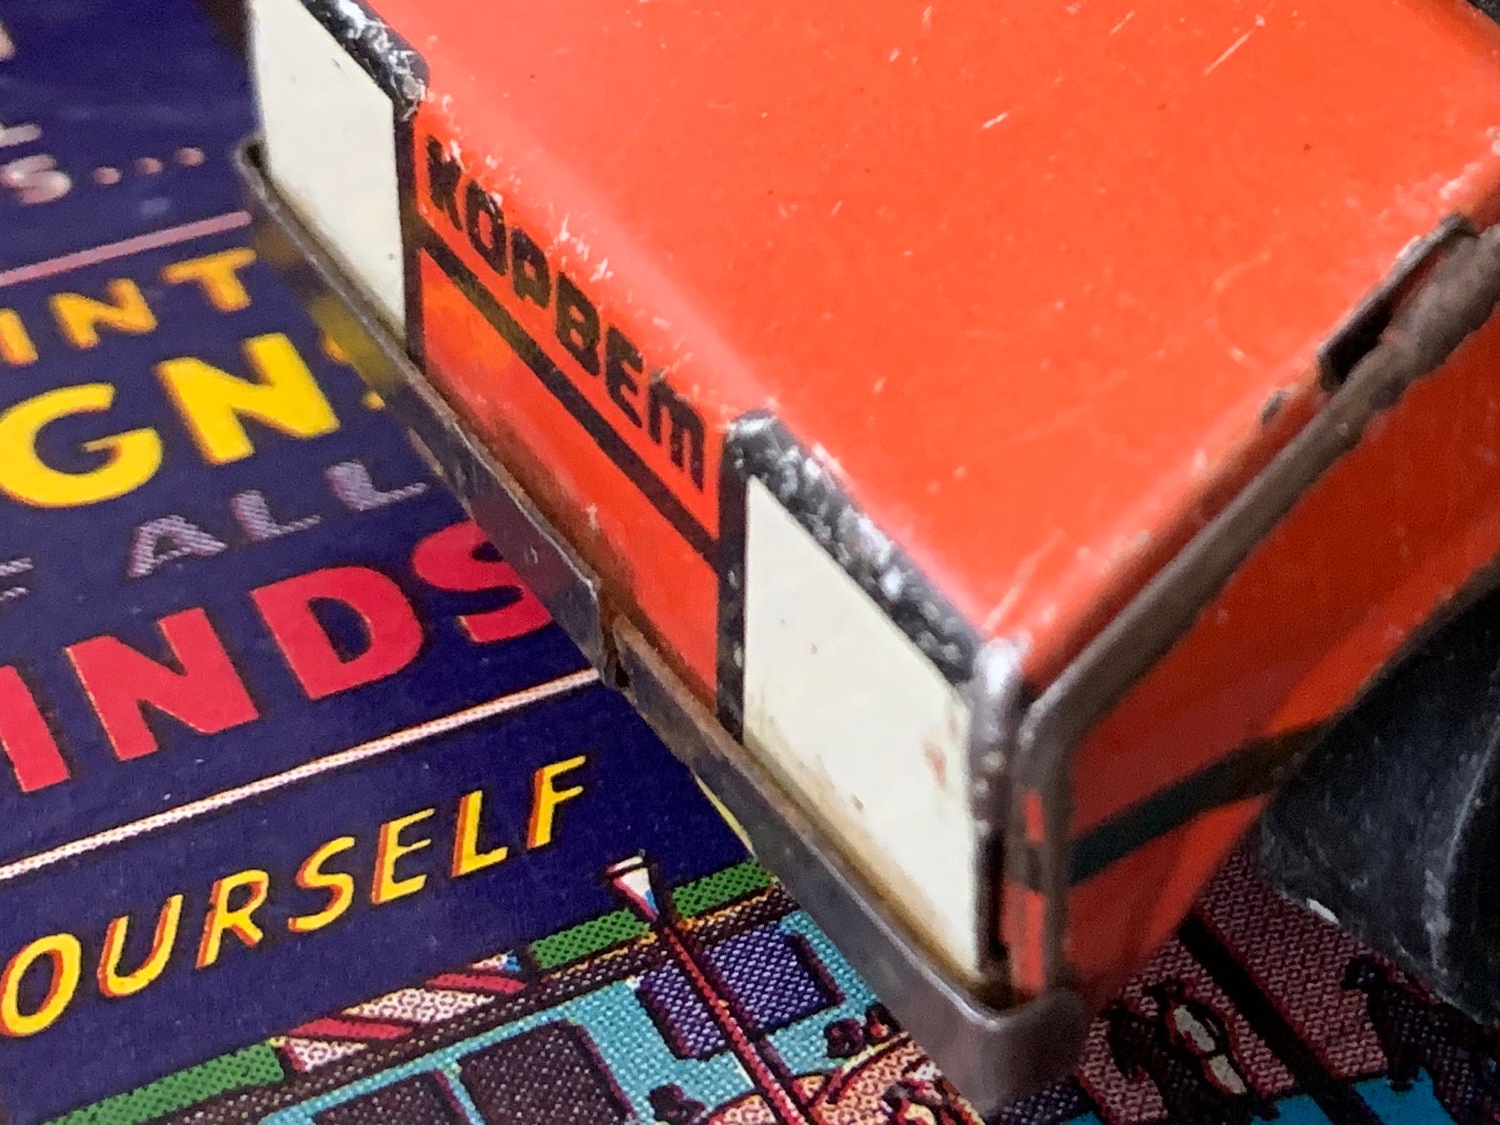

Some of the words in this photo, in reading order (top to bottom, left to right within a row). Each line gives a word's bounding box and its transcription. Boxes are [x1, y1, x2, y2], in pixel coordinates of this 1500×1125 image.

[0, 331, 386, 509] GN
[125, 459, 430, 580] ALL
[0, 520, 552, 792] INDS
[0, 755, 587, 1038] OURSELF
